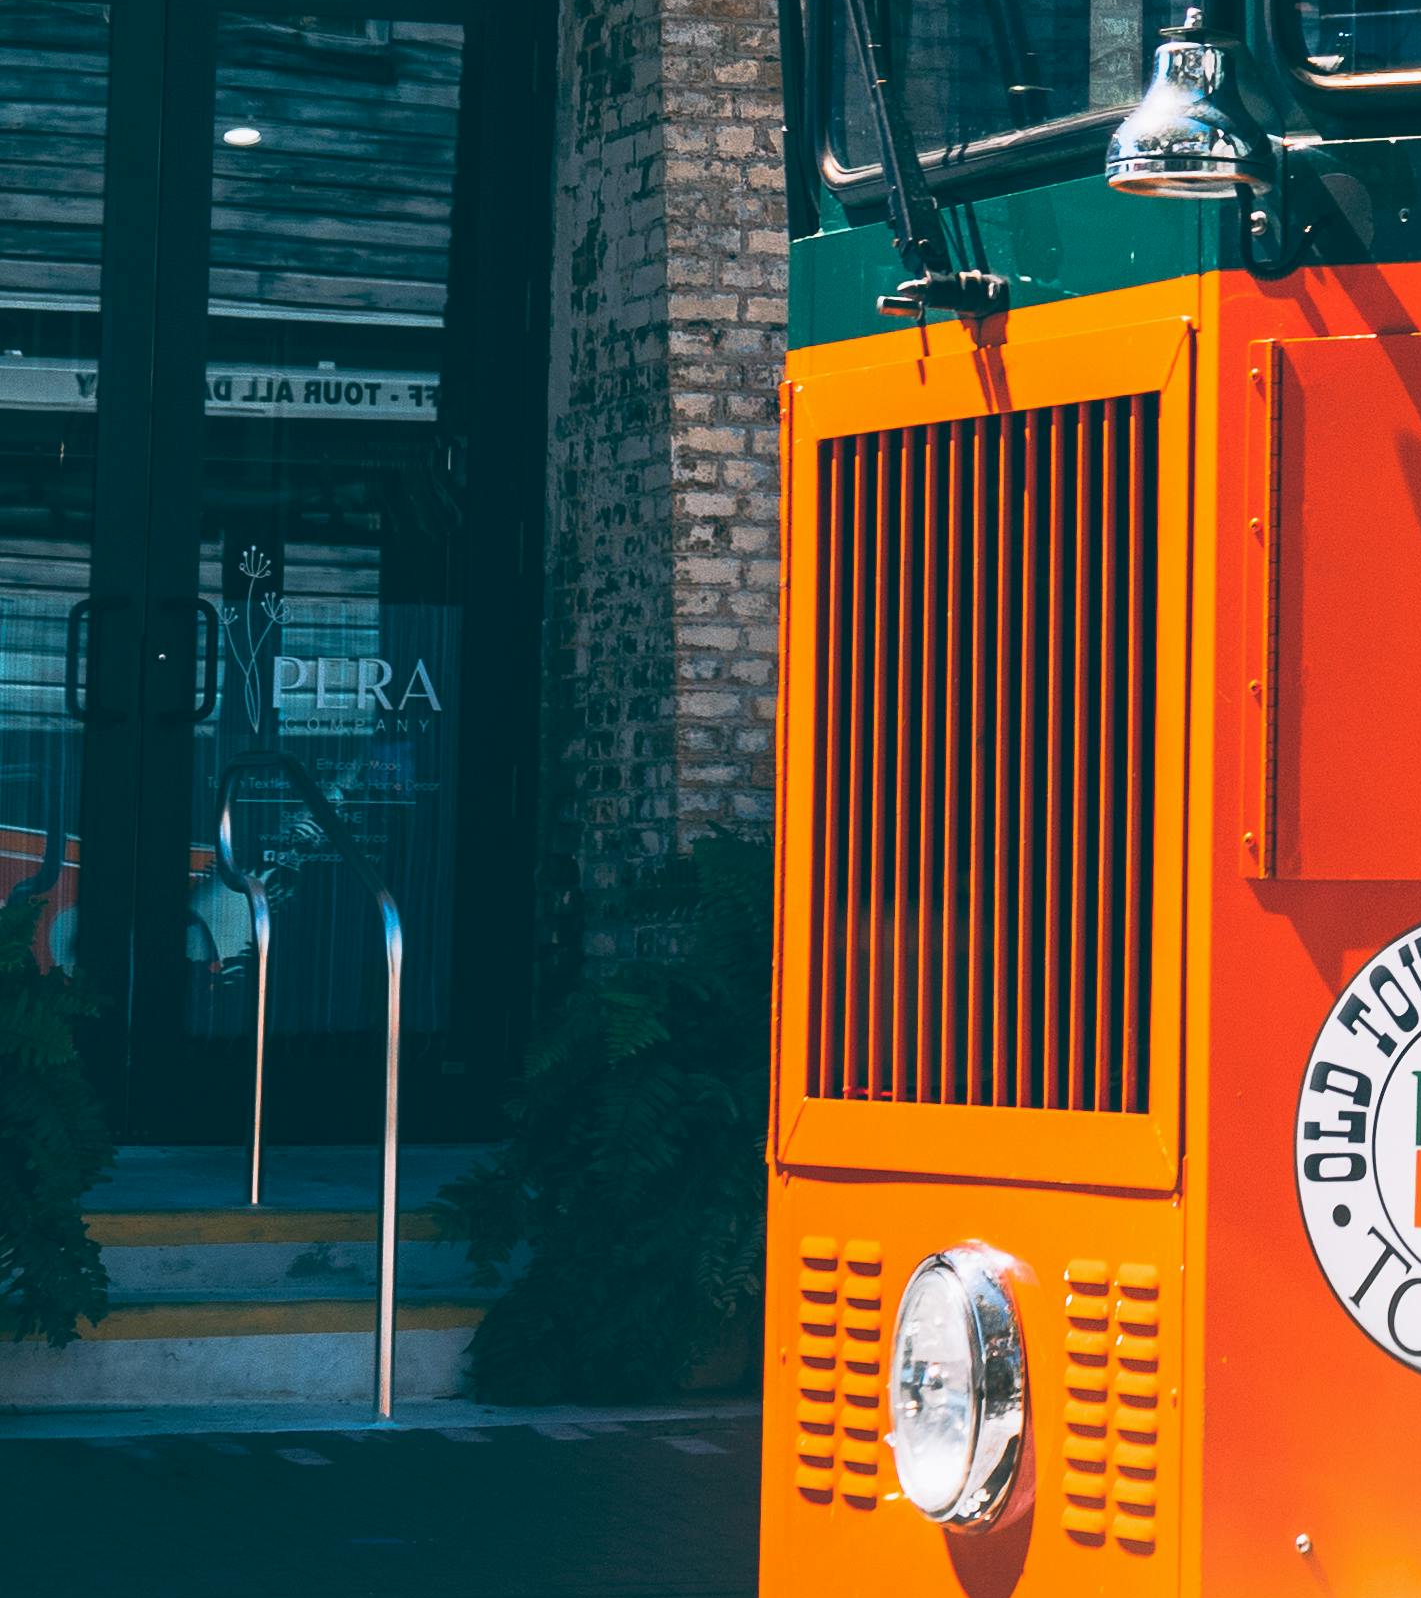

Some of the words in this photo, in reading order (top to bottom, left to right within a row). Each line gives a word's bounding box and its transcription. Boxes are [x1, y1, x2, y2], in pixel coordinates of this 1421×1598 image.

[272, 656, 442, 711] PERA
[284, 716, 431, 734] COMPANY
[1303, 1059, 1374, 1184] OLD
